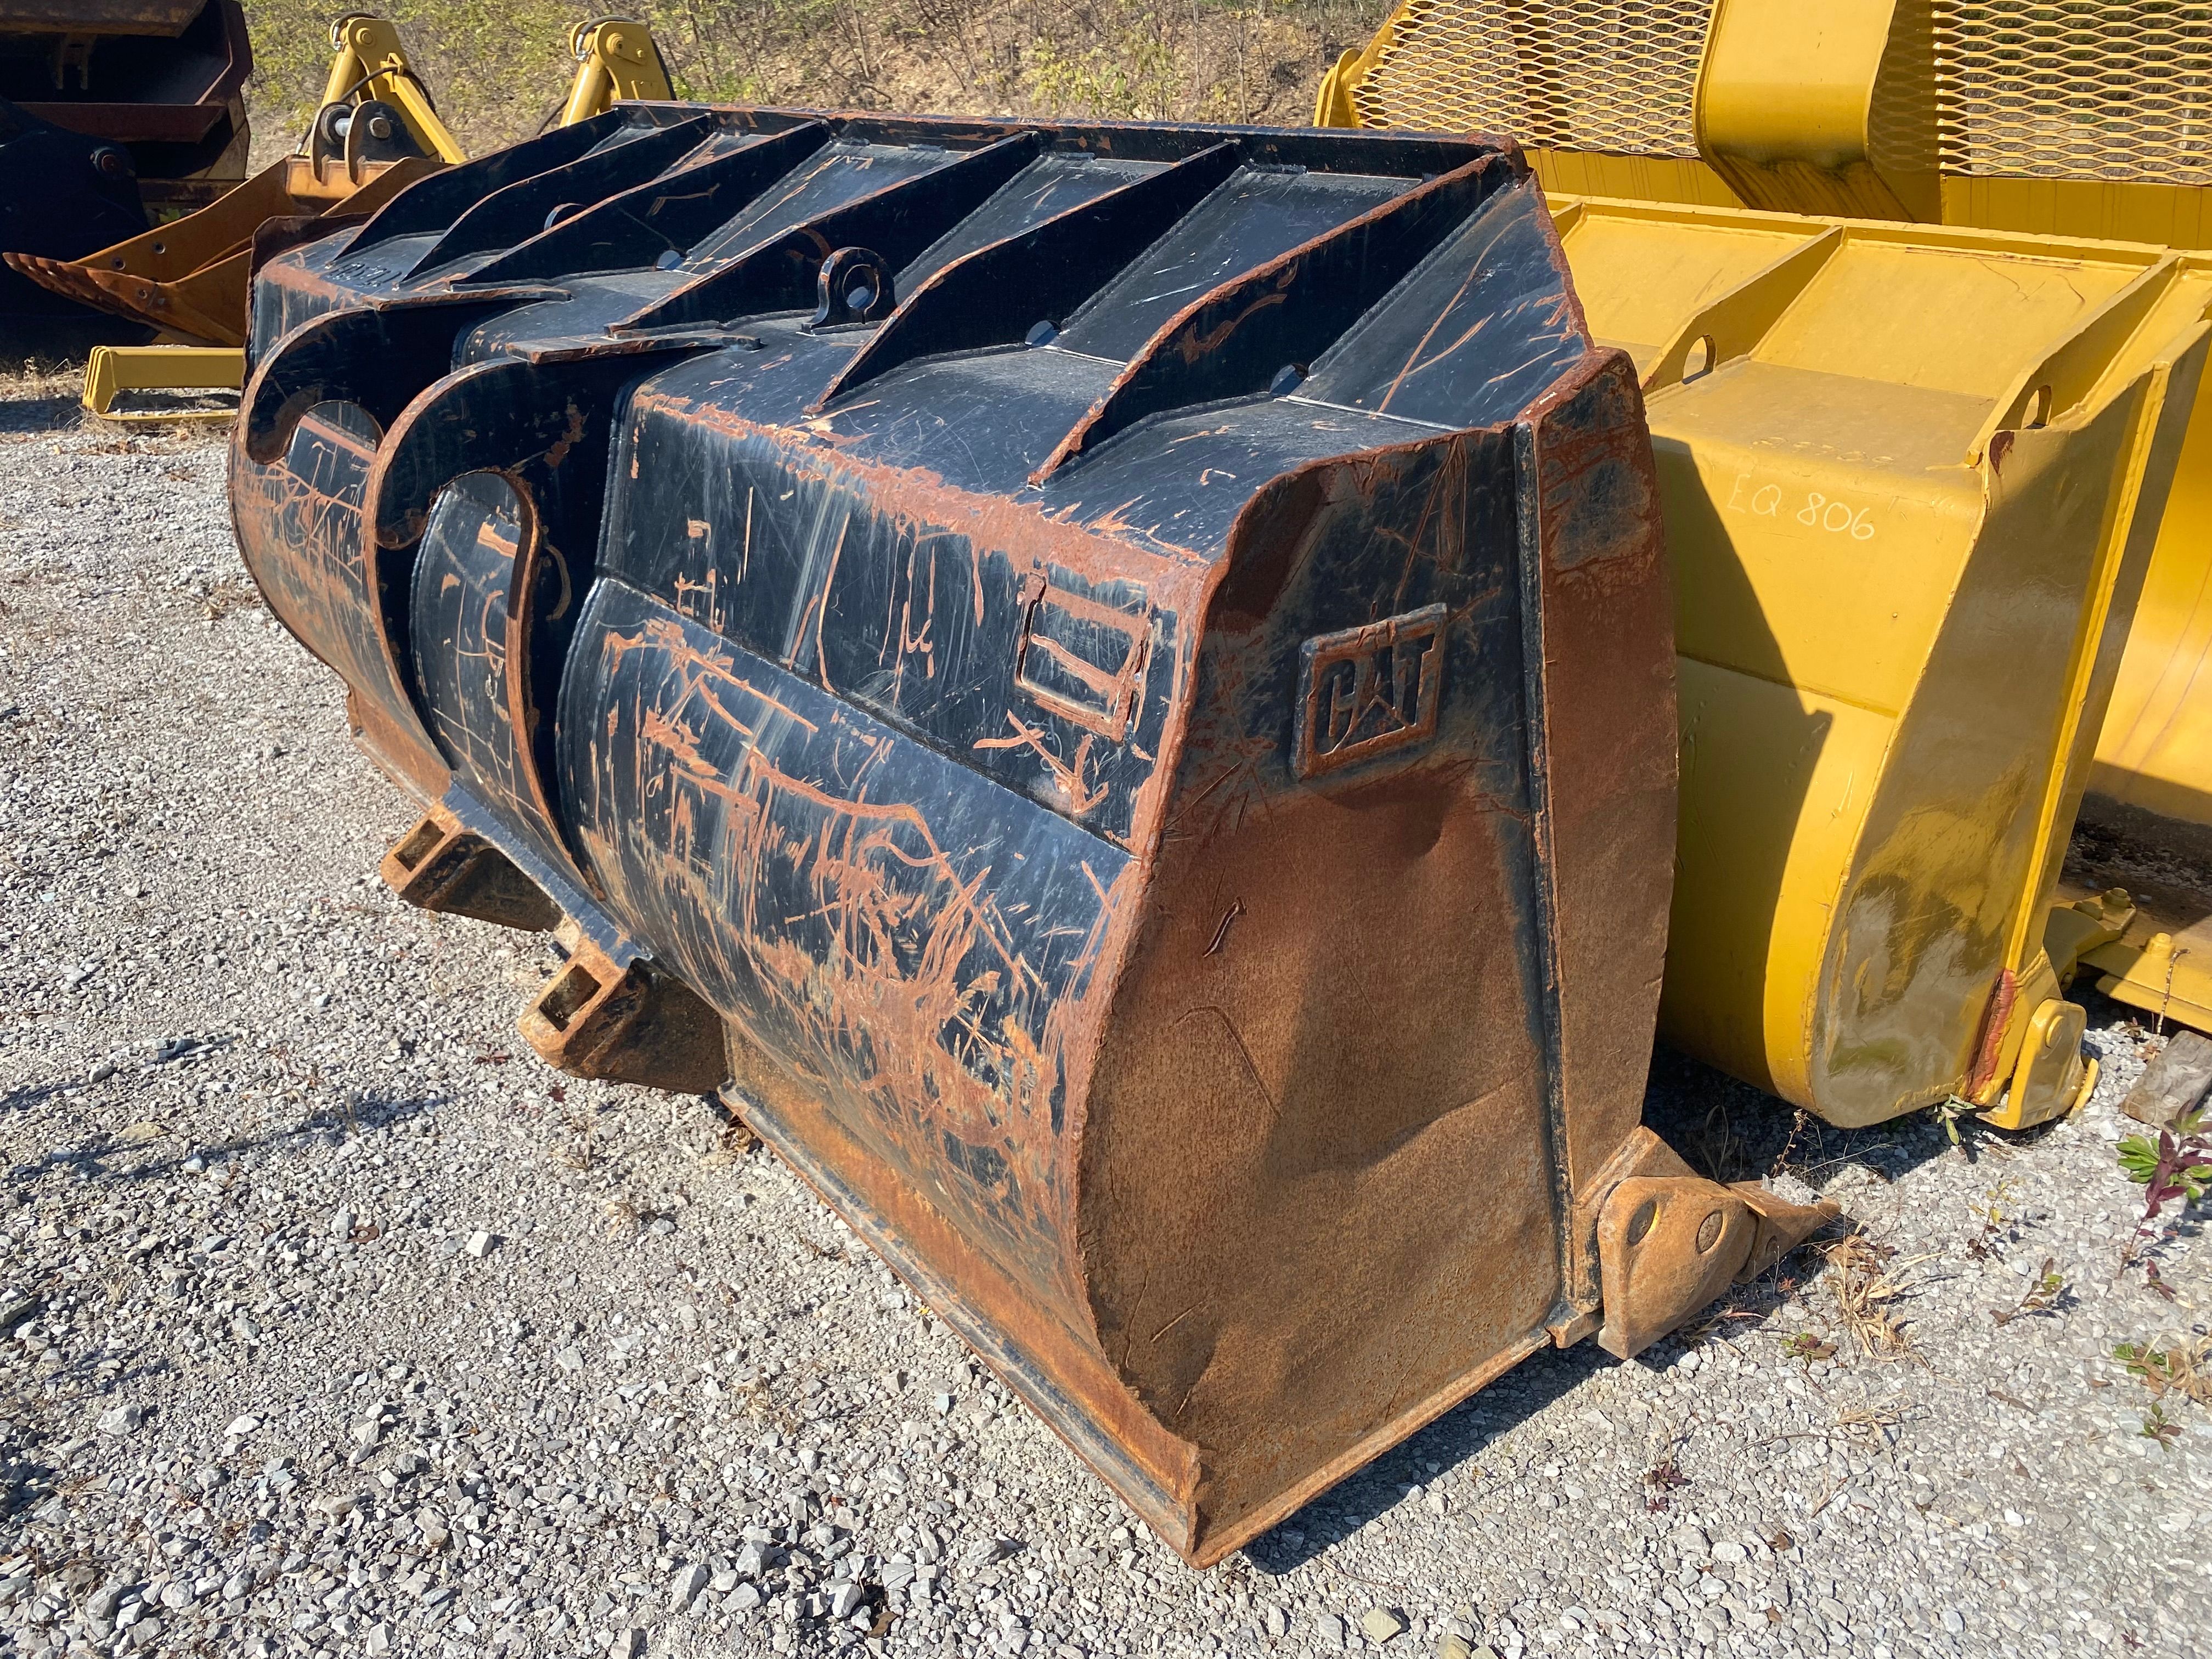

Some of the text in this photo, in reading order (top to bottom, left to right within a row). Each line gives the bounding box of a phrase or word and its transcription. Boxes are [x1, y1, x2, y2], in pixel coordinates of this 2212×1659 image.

[1726, 473, 1875, 540] EQ 806
[1313, 631, 1436, 758] CAT
